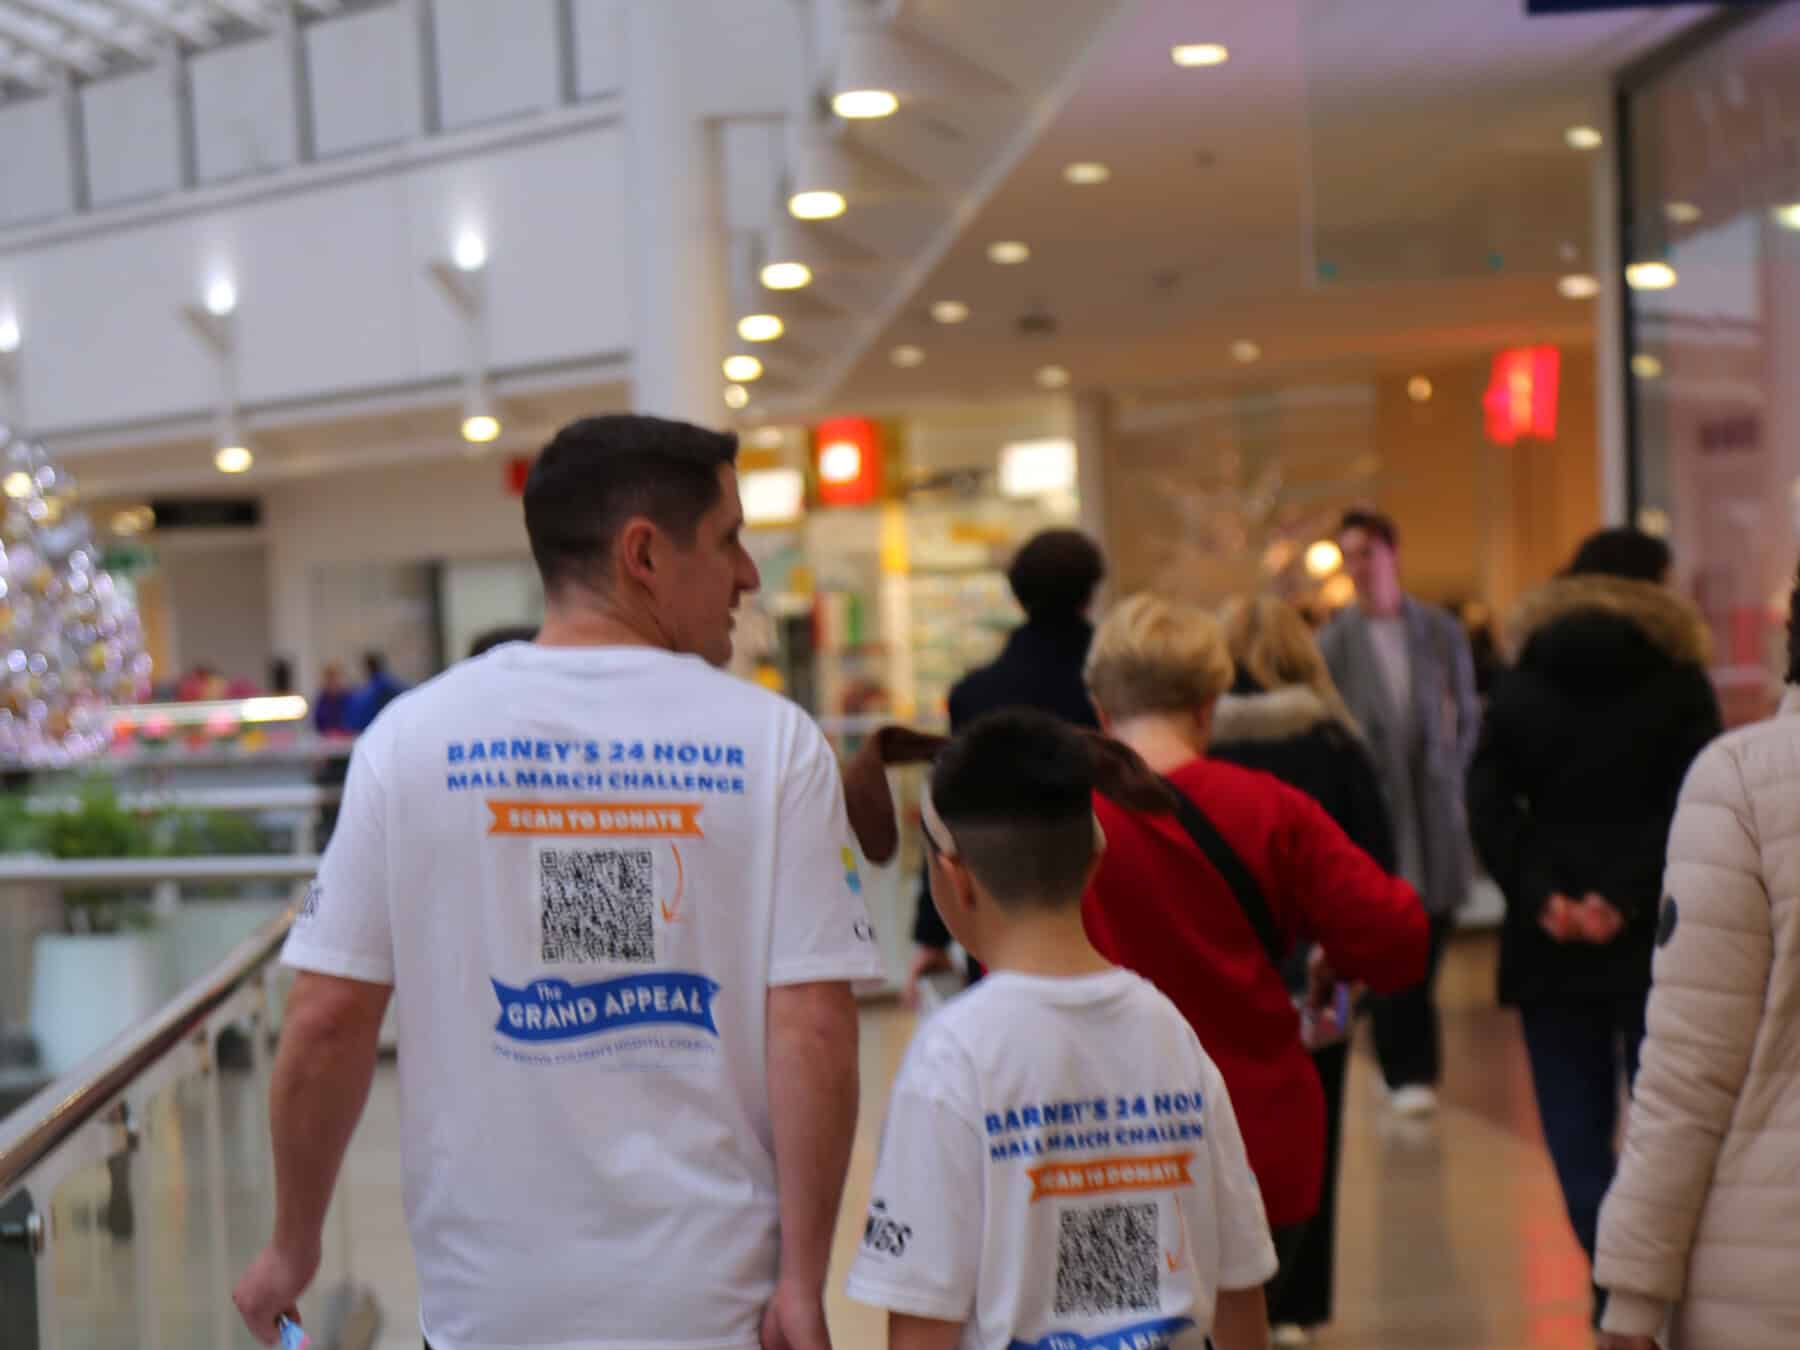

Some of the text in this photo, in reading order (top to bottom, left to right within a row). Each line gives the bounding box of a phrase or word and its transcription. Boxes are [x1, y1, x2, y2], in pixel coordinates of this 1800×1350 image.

[447, 739, 744, 767] BARNEY'S 24 HOUR
[447, 770, 744, 794] MALL MARCH CHALLENGE
[508, 808, 683, 831] SCAN TO DONATE
[507, 984, 704, 1030] GRAND APPEAL
